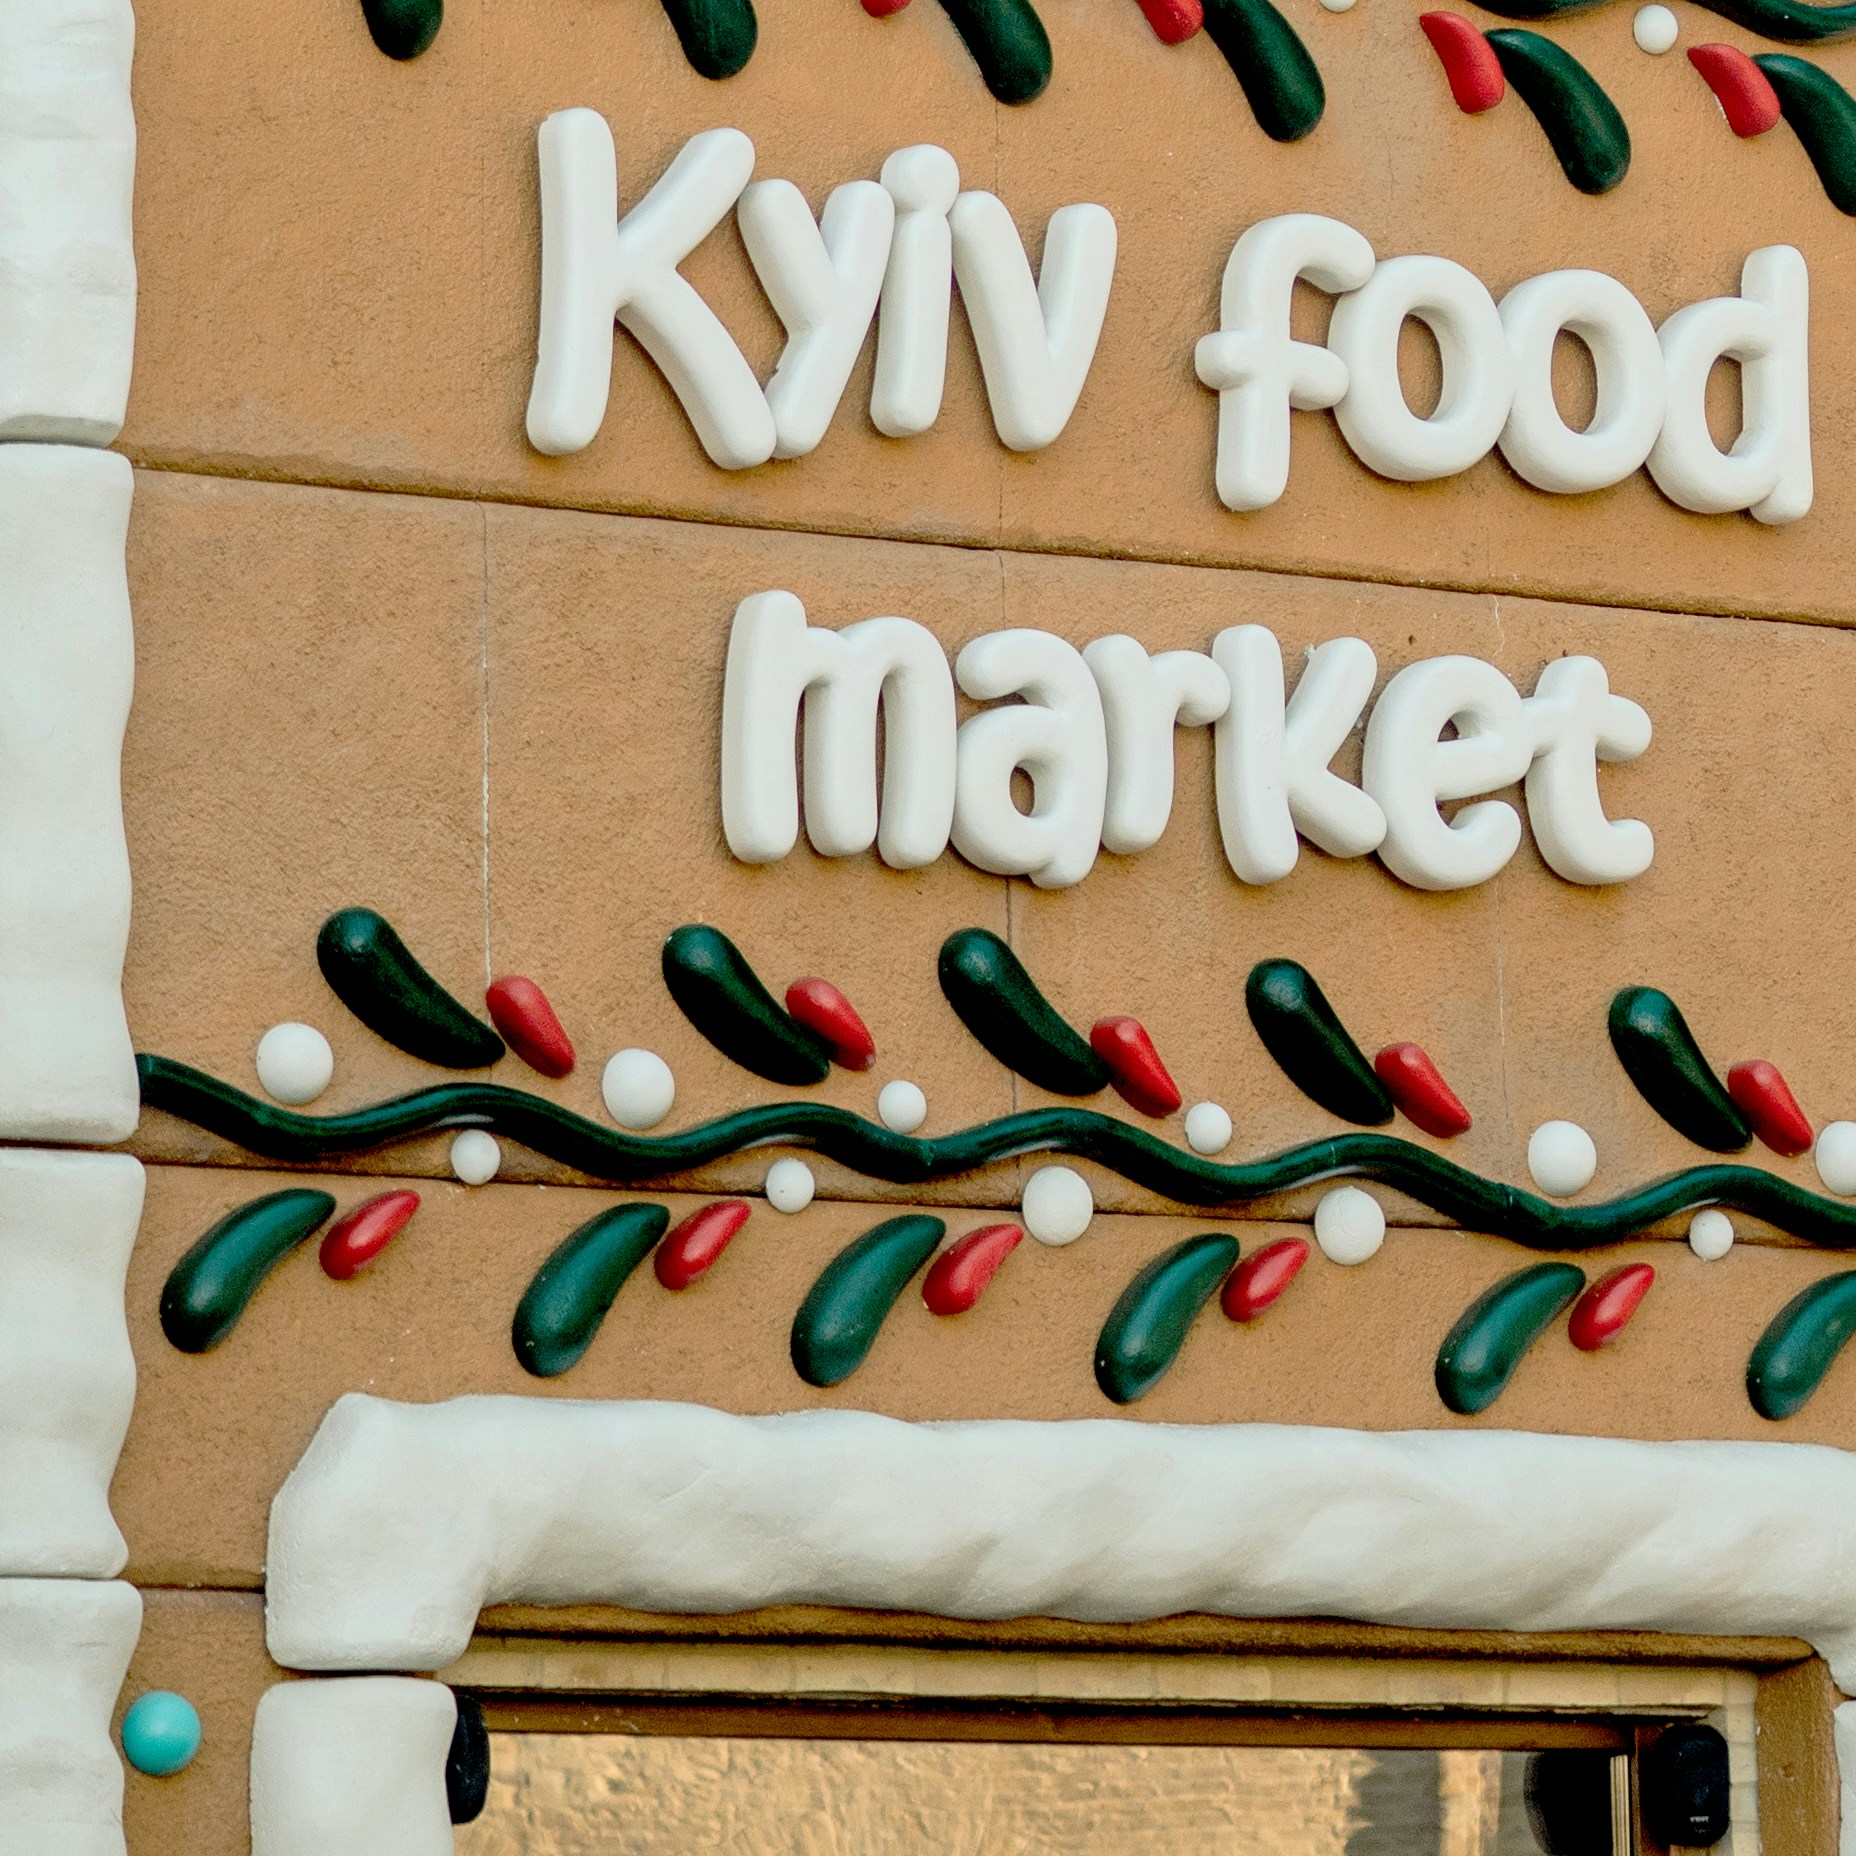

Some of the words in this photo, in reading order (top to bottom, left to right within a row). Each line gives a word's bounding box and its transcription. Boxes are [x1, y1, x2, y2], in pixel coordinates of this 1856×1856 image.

[527, 107, 1118, 469] Kyiv
[1196, 212, 1813, 525] food
[721, 590, 1654, 889] market
